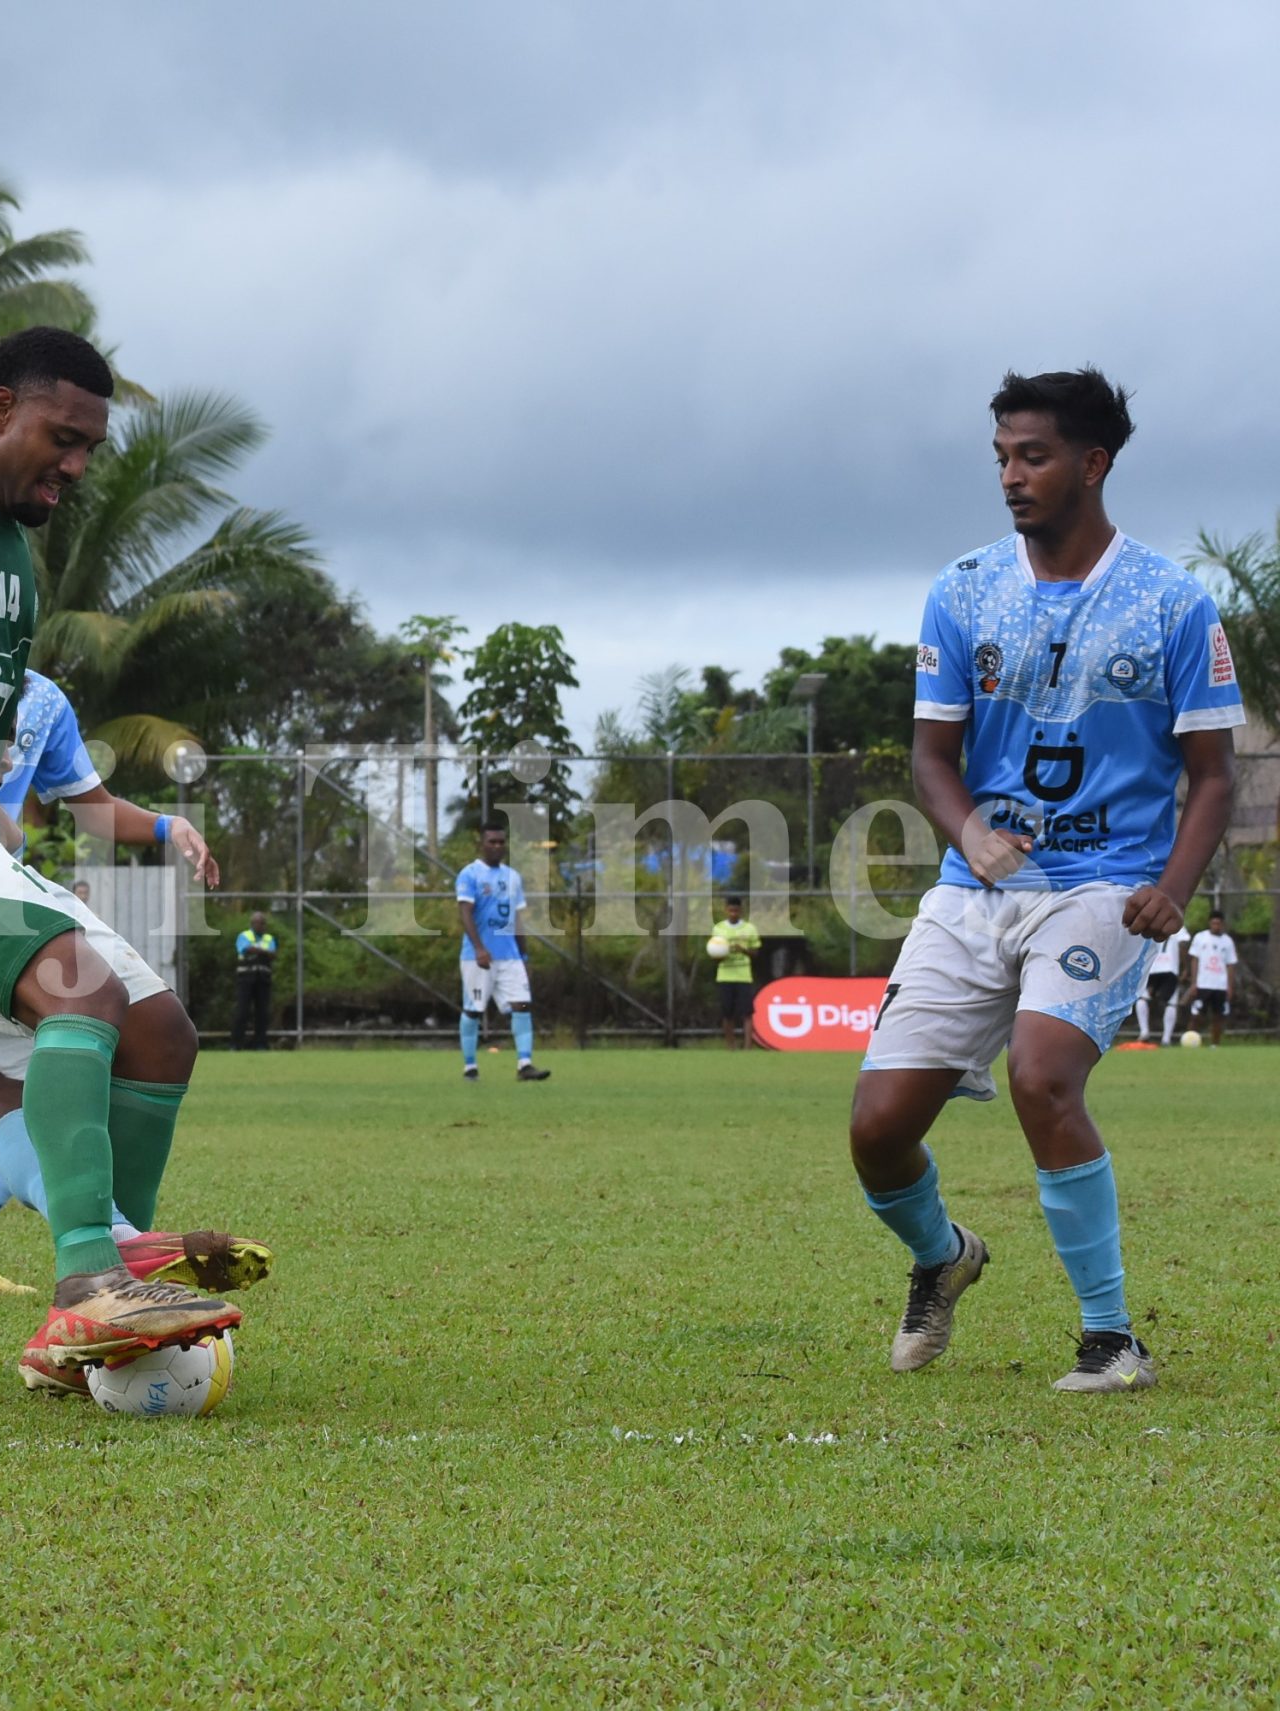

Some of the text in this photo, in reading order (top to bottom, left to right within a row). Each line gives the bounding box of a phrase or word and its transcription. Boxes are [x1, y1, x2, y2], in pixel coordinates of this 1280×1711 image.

[1049, 642, 1067, 688] 7
[1038, 838, 1109, 852] PACIFIC
[817, 1003, 878, 1033] Digi
[874, 983, 902, 1031] 7
